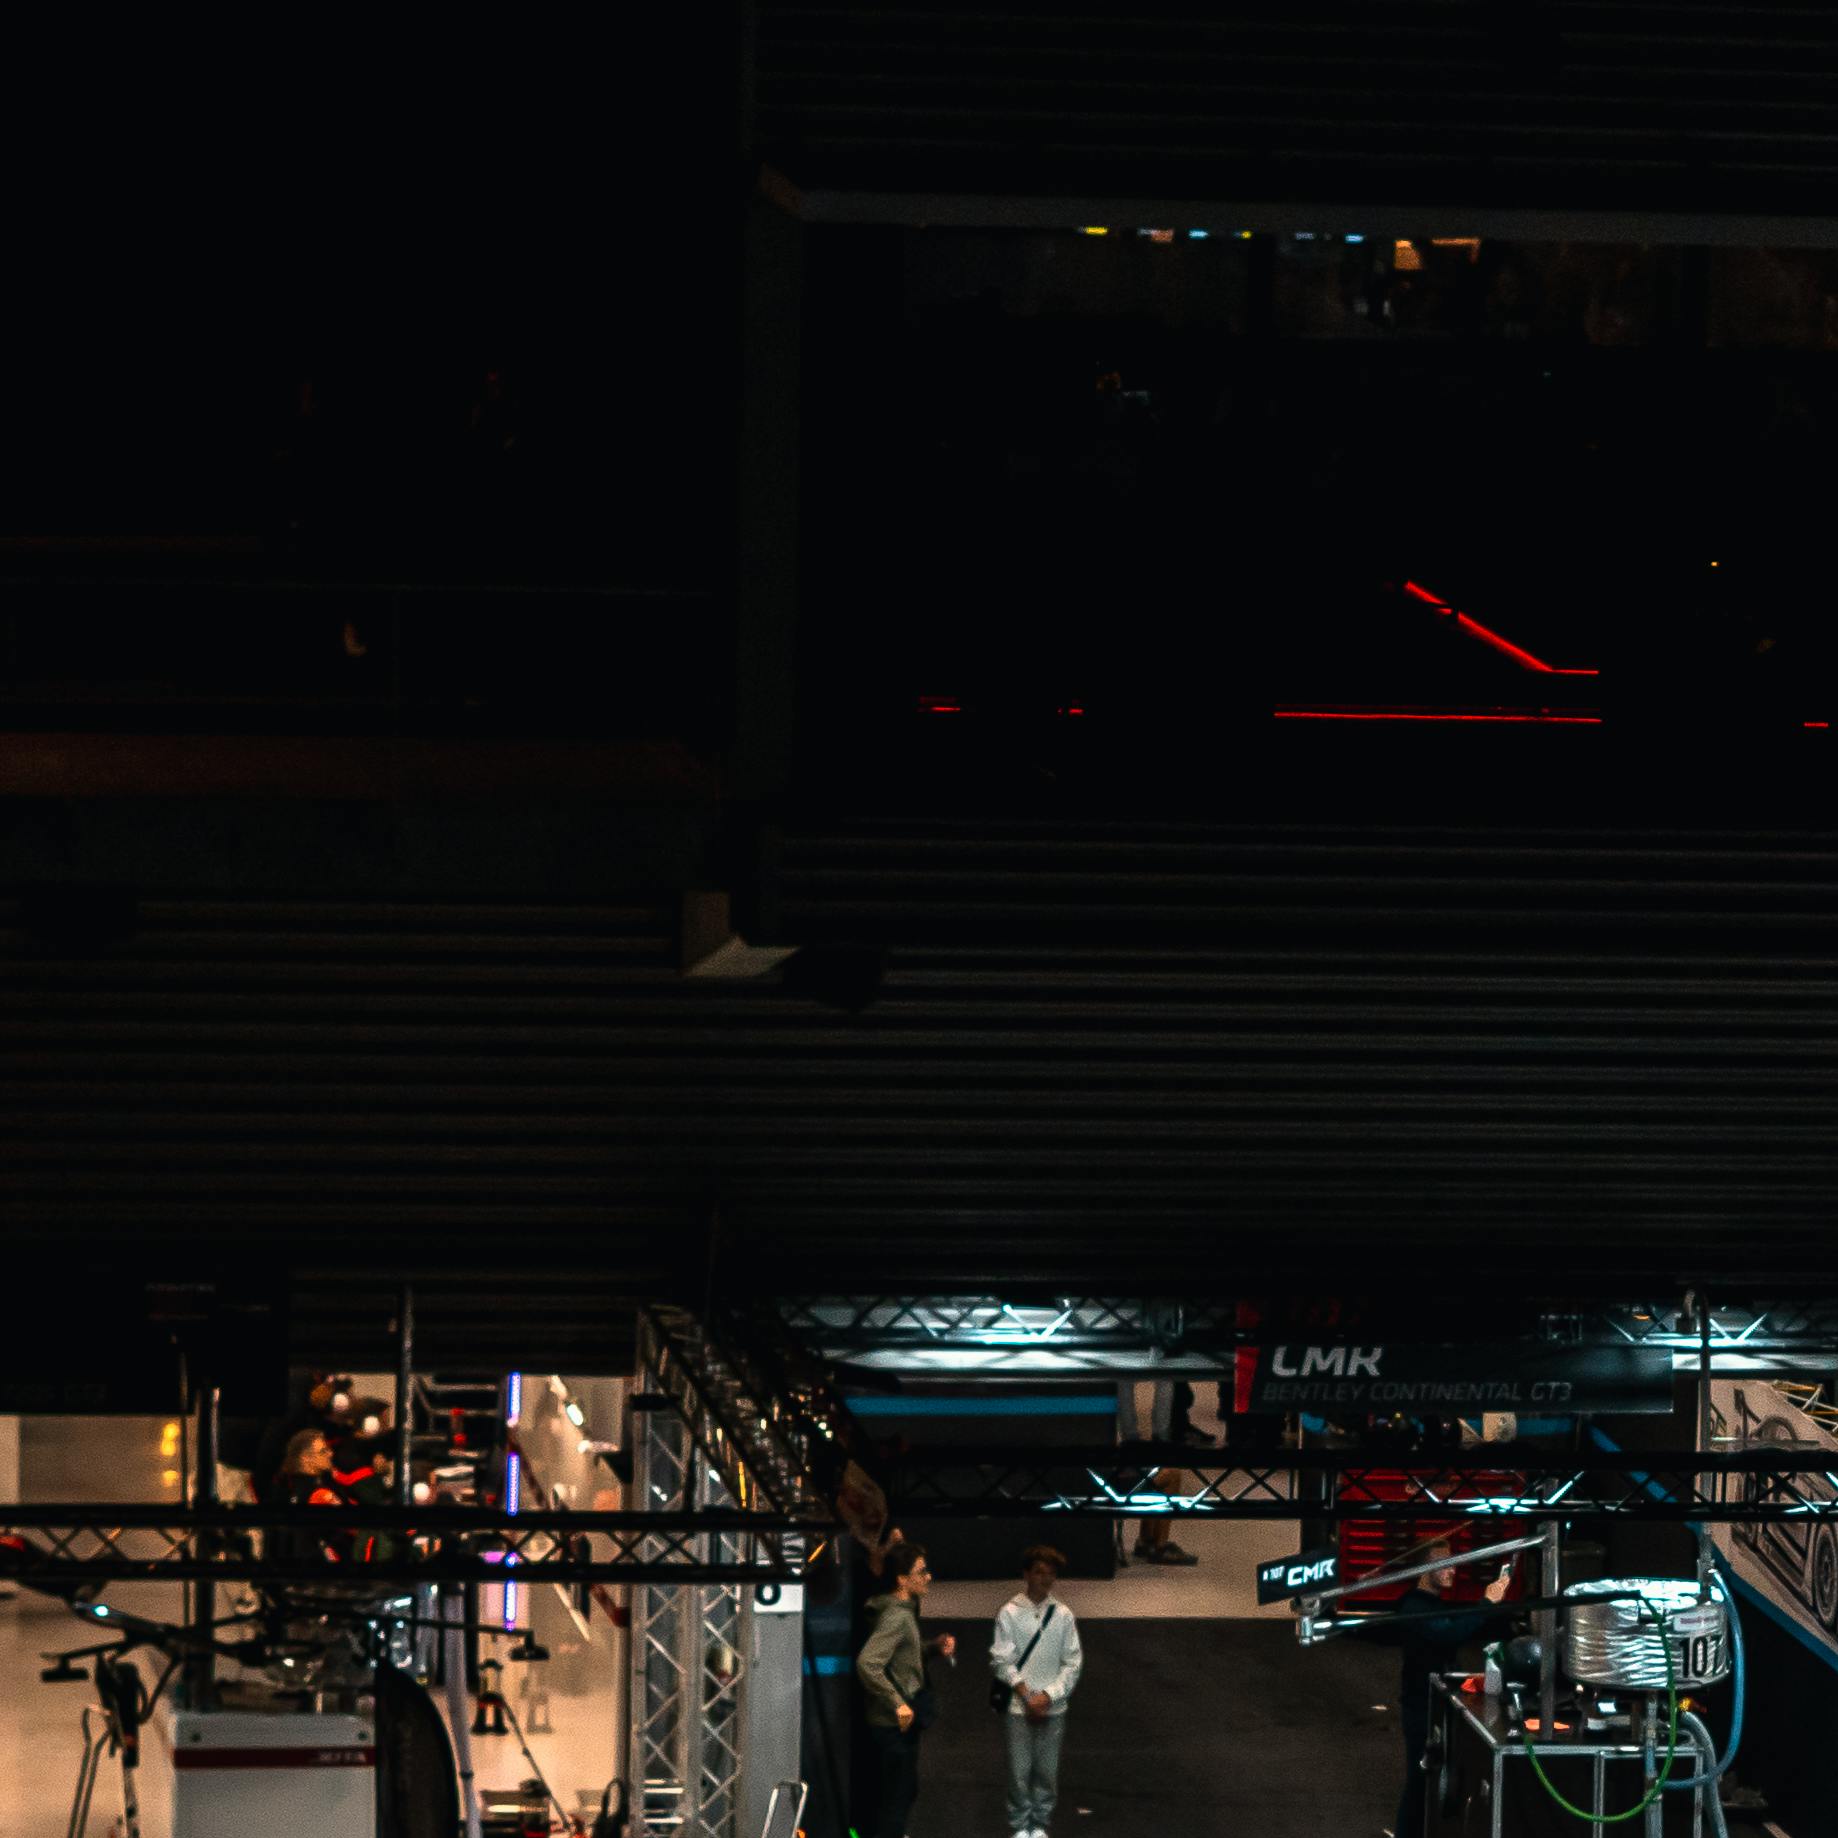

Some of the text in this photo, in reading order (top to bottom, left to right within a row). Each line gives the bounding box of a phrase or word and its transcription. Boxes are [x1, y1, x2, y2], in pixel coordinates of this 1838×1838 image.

[1264, 1382, 1575, 1401] BENTLEY CONTINENTAL GT3
[1287, 1558, 1336, 1587] CMR
